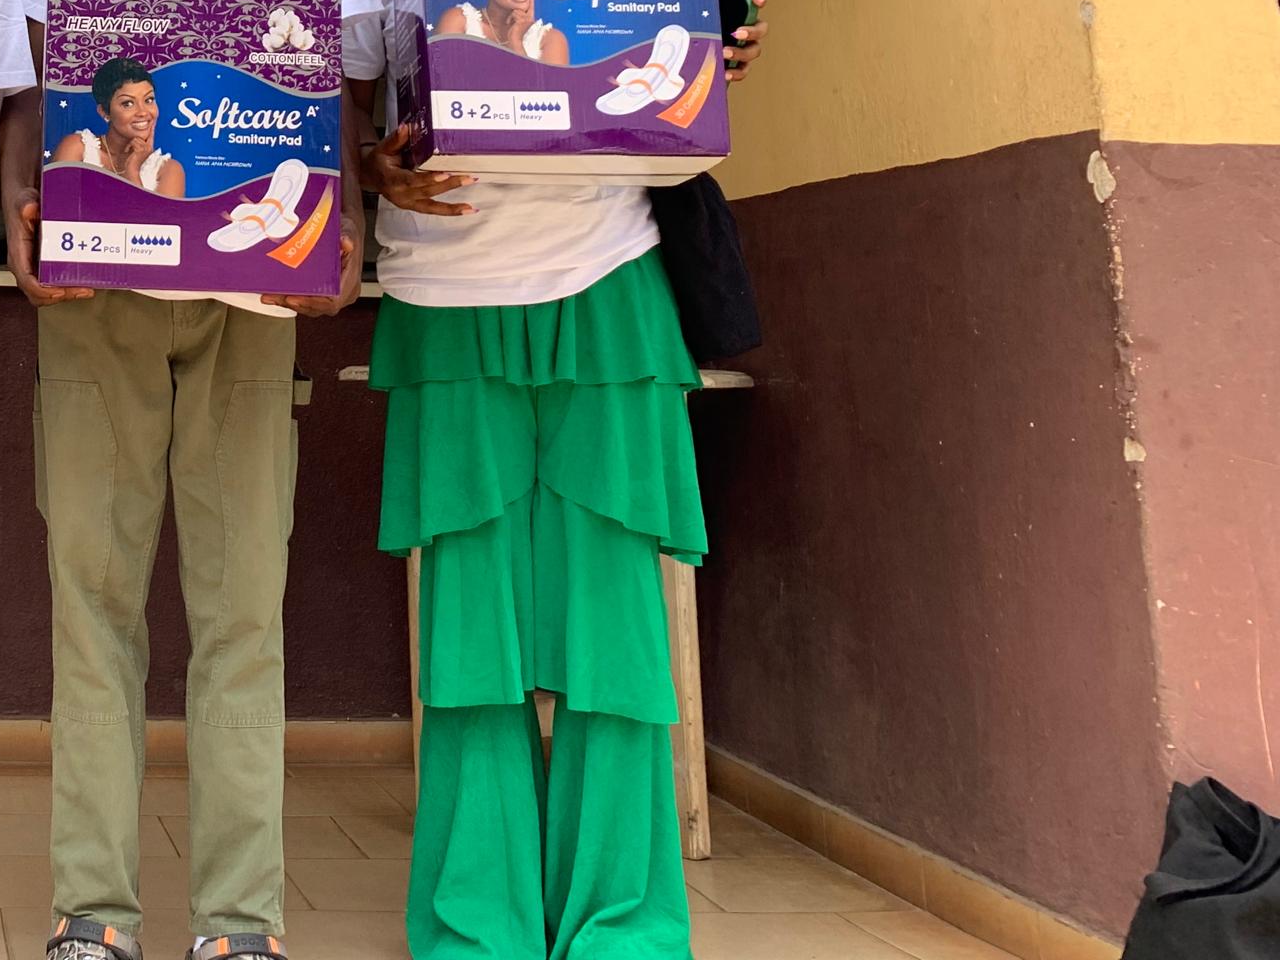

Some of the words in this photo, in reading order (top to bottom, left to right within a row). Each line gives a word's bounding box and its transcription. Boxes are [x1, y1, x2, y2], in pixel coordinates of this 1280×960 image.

[607, 2, 655, 14] Sanitary
[657, 2, 680, 13] Pad
[66, 16, 120, 31] HEAVY
[120, 16, 169, 33] FLOW
[250, 52, 294, 65] COTTON
[295, 53, 324, 66] FEEL
[171, 96, 302, 139] Softcare
[228, 133, 276, 147] Sanitary
[278, 135, 302, 146] Pad
[103, 245, 120, 253] PCS
[130, 246, 153, 255] Heavy
[285, 247, 298, 258] 3D
